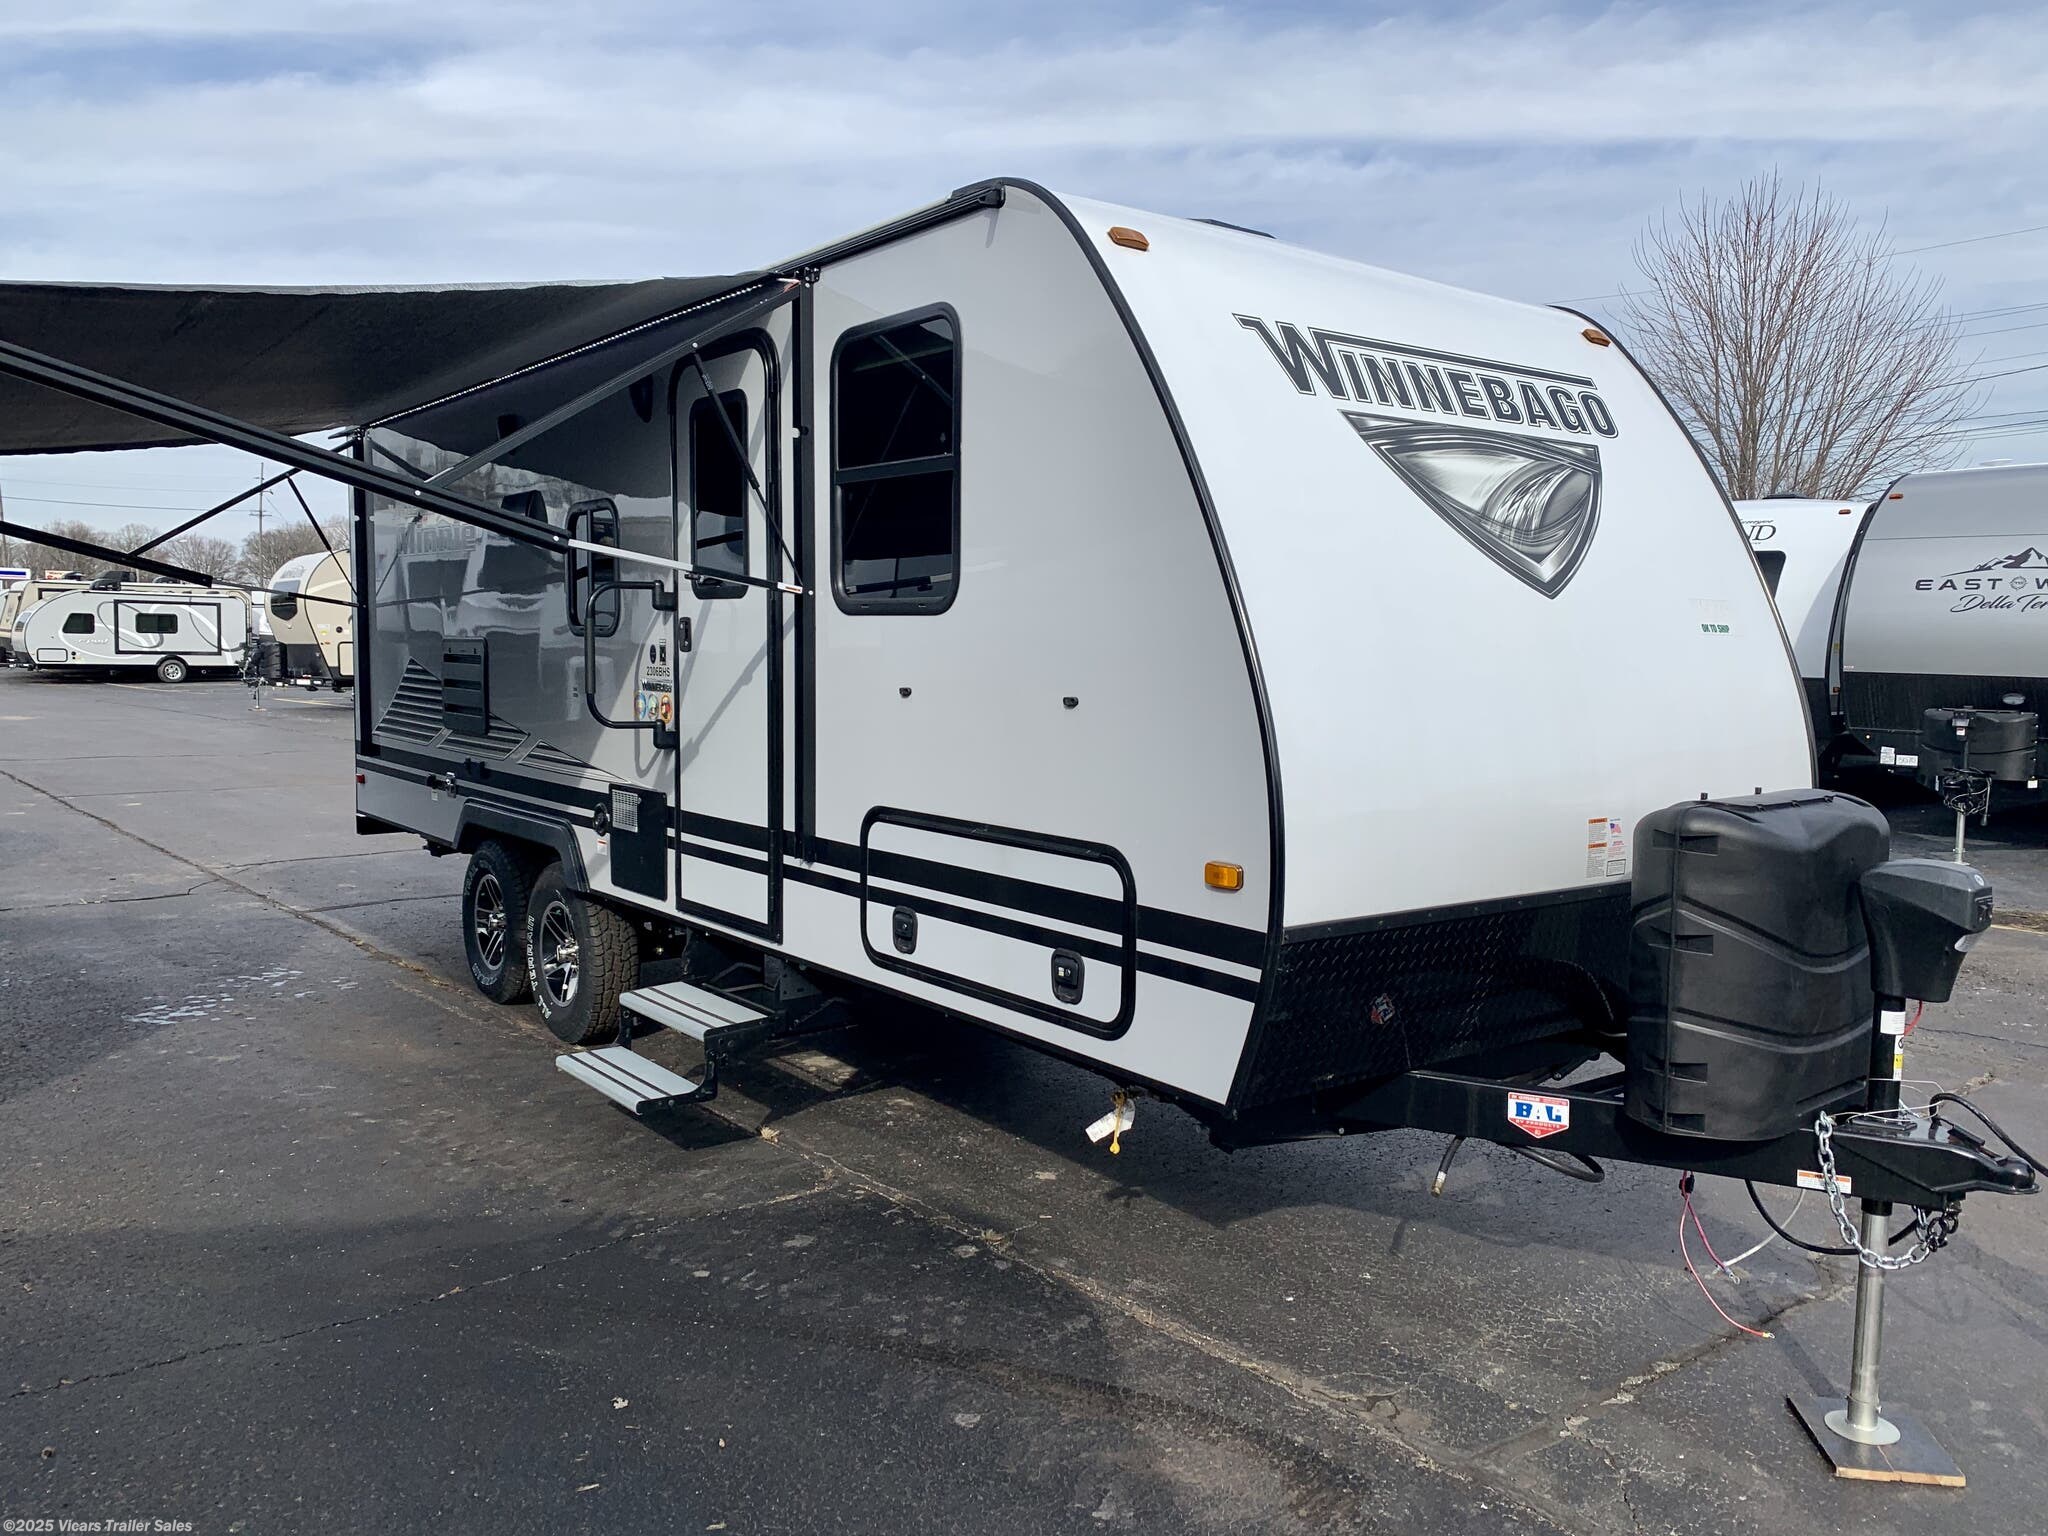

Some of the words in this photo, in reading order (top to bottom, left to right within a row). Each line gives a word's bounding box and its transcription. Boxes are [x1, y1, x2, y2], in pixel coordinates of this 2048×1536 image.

[1232, 312, 1618, 438] WINNEBAGO
[1915, 578, 2003, 591] EAST
[1950, 593, 2015, 613] Della
